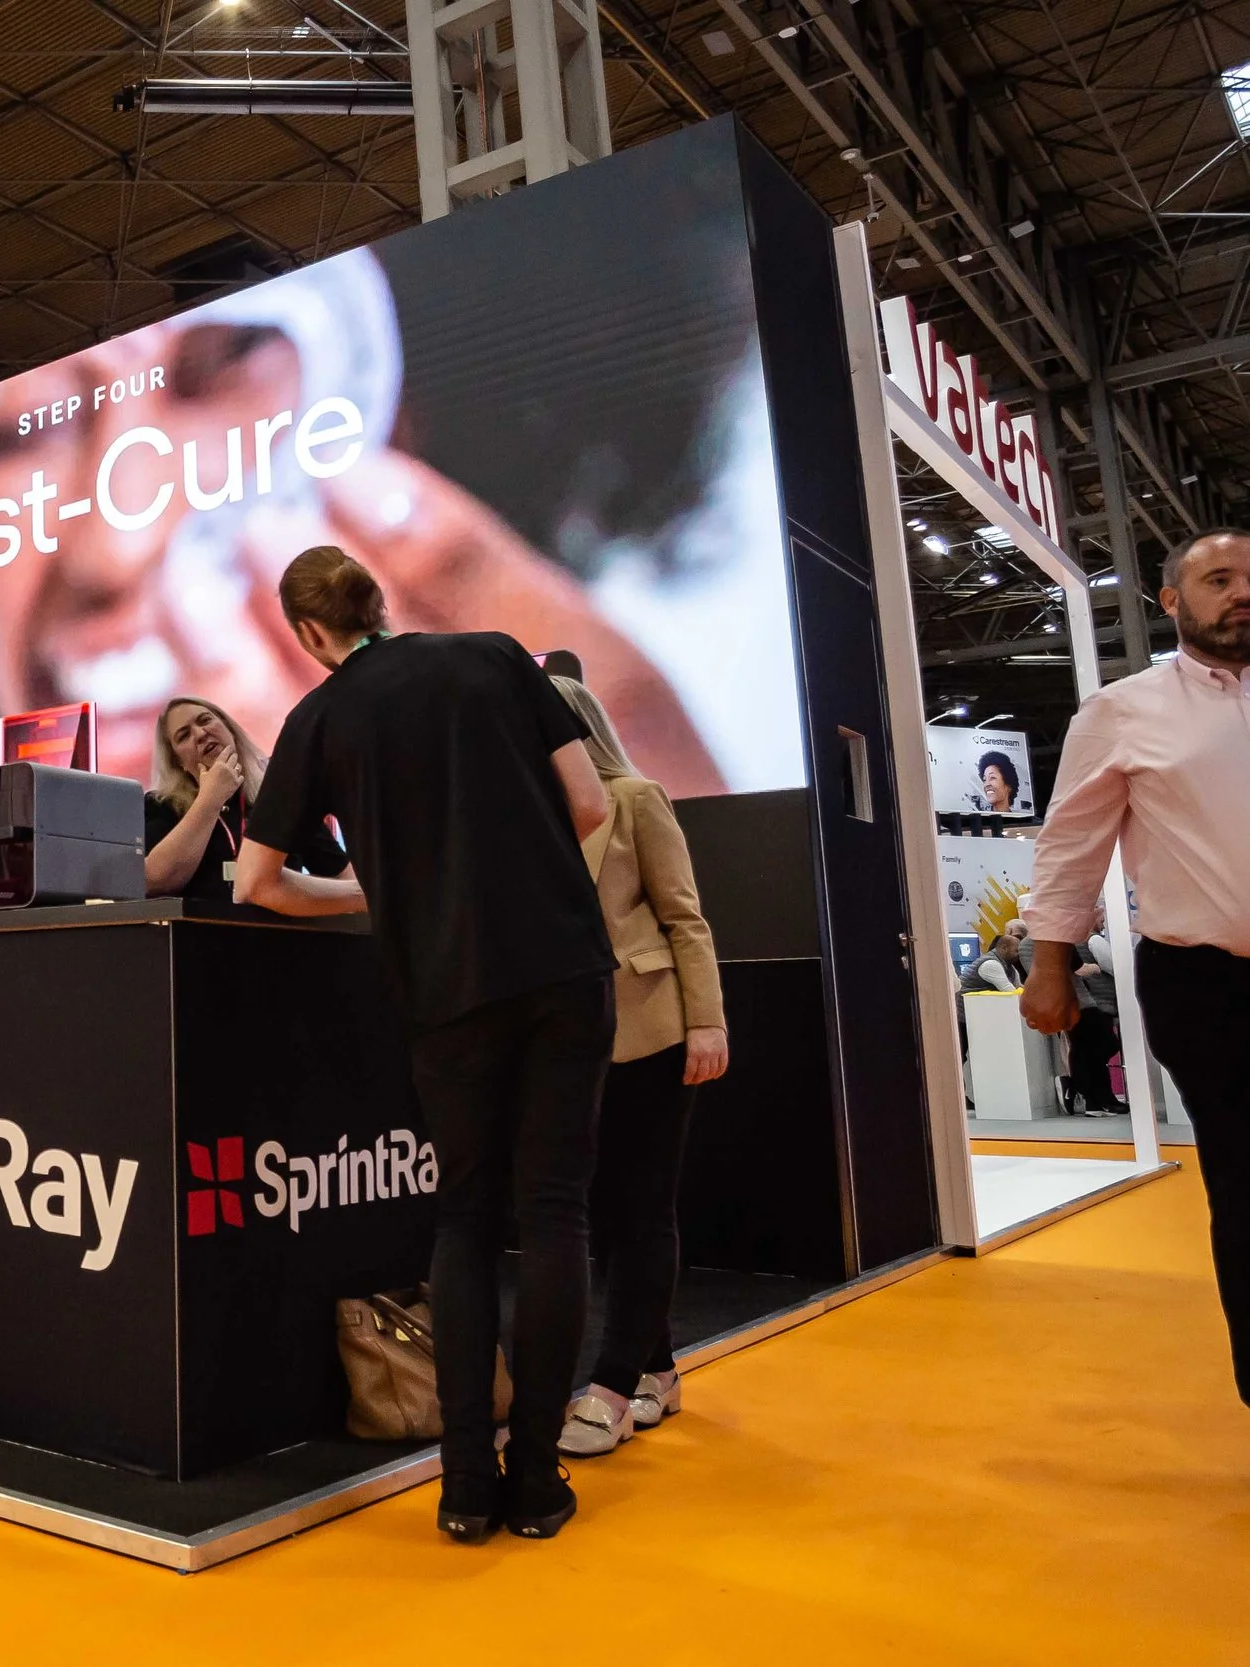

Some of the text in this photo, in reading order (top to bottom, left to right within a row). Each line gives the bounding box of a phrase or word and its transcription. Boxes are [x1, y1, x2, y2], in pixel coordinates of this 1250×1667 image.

[17, 365, 167, 436] STEP FOUR
[979, 736, 1020, 747] Carestream
[254, 1128, 439, 1234] SprintRa
